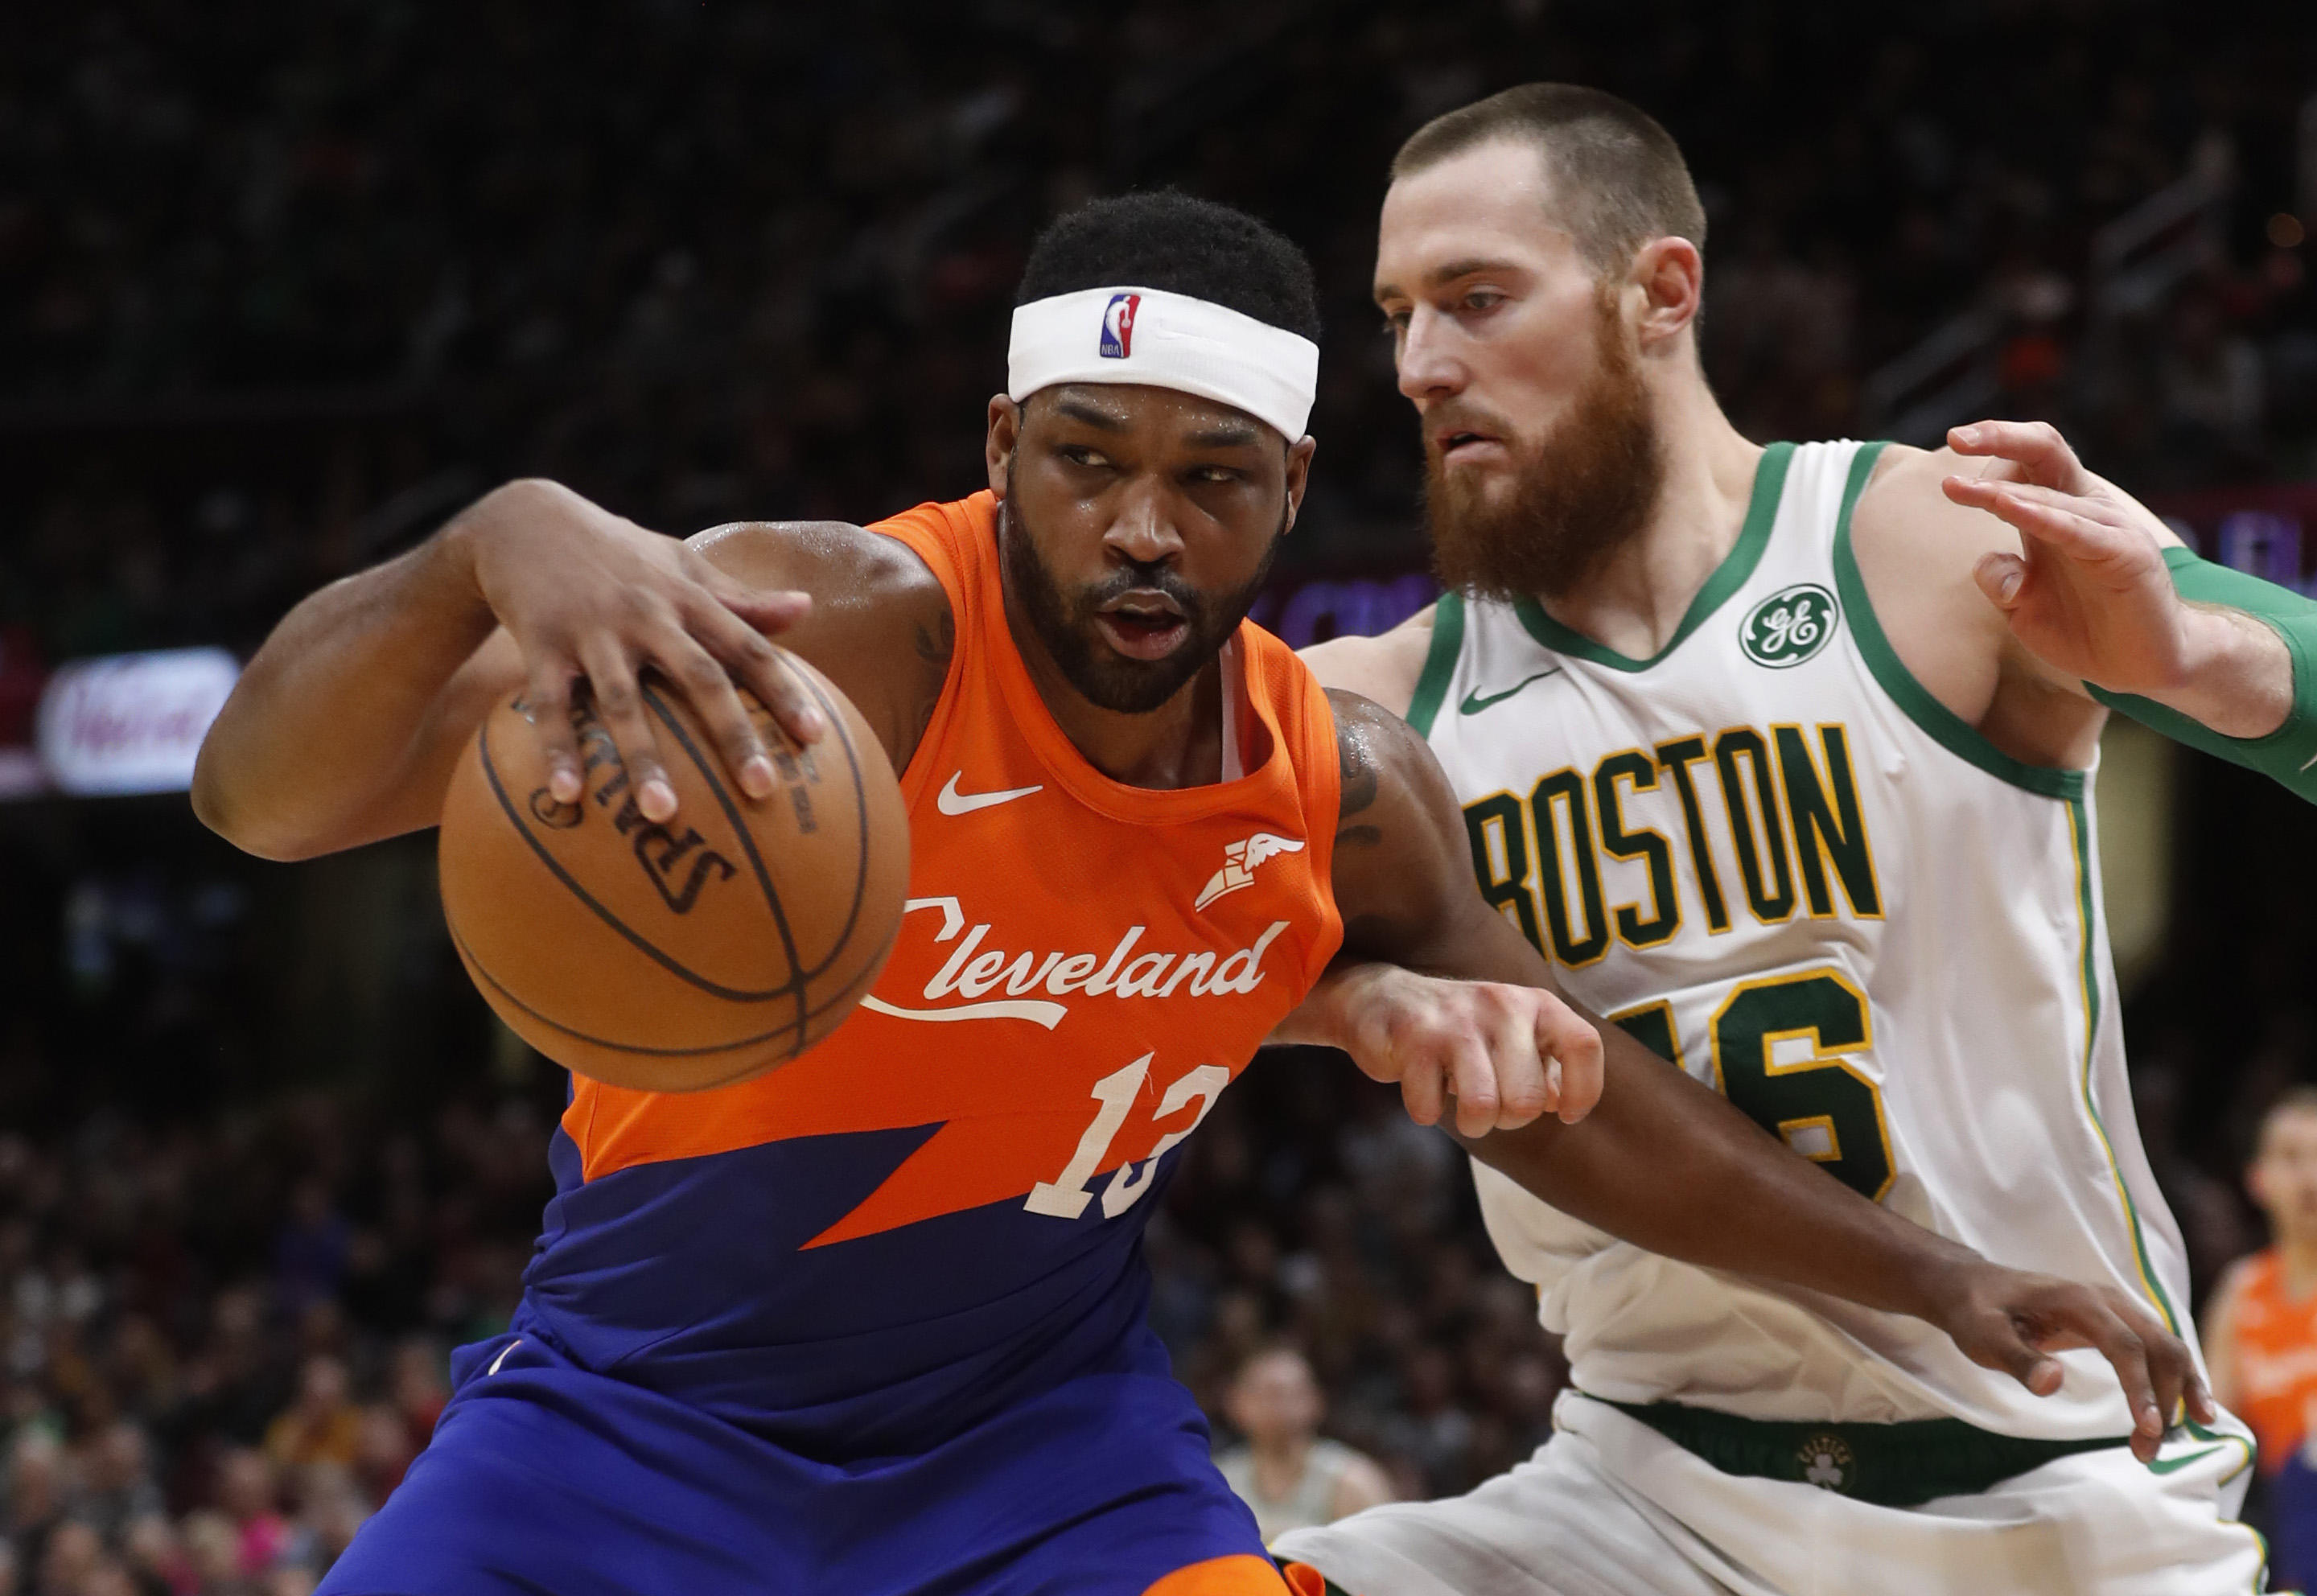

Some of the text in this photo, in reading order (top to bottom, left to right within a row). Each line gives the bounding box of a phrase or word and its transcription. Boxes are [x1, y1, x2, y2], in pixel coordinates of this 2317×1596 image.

[1101, 343, 1120, 356] NBA
[1463, 723, 1885, 970] BOSTON
[859, 895, 1290, 1030] Cleveland
